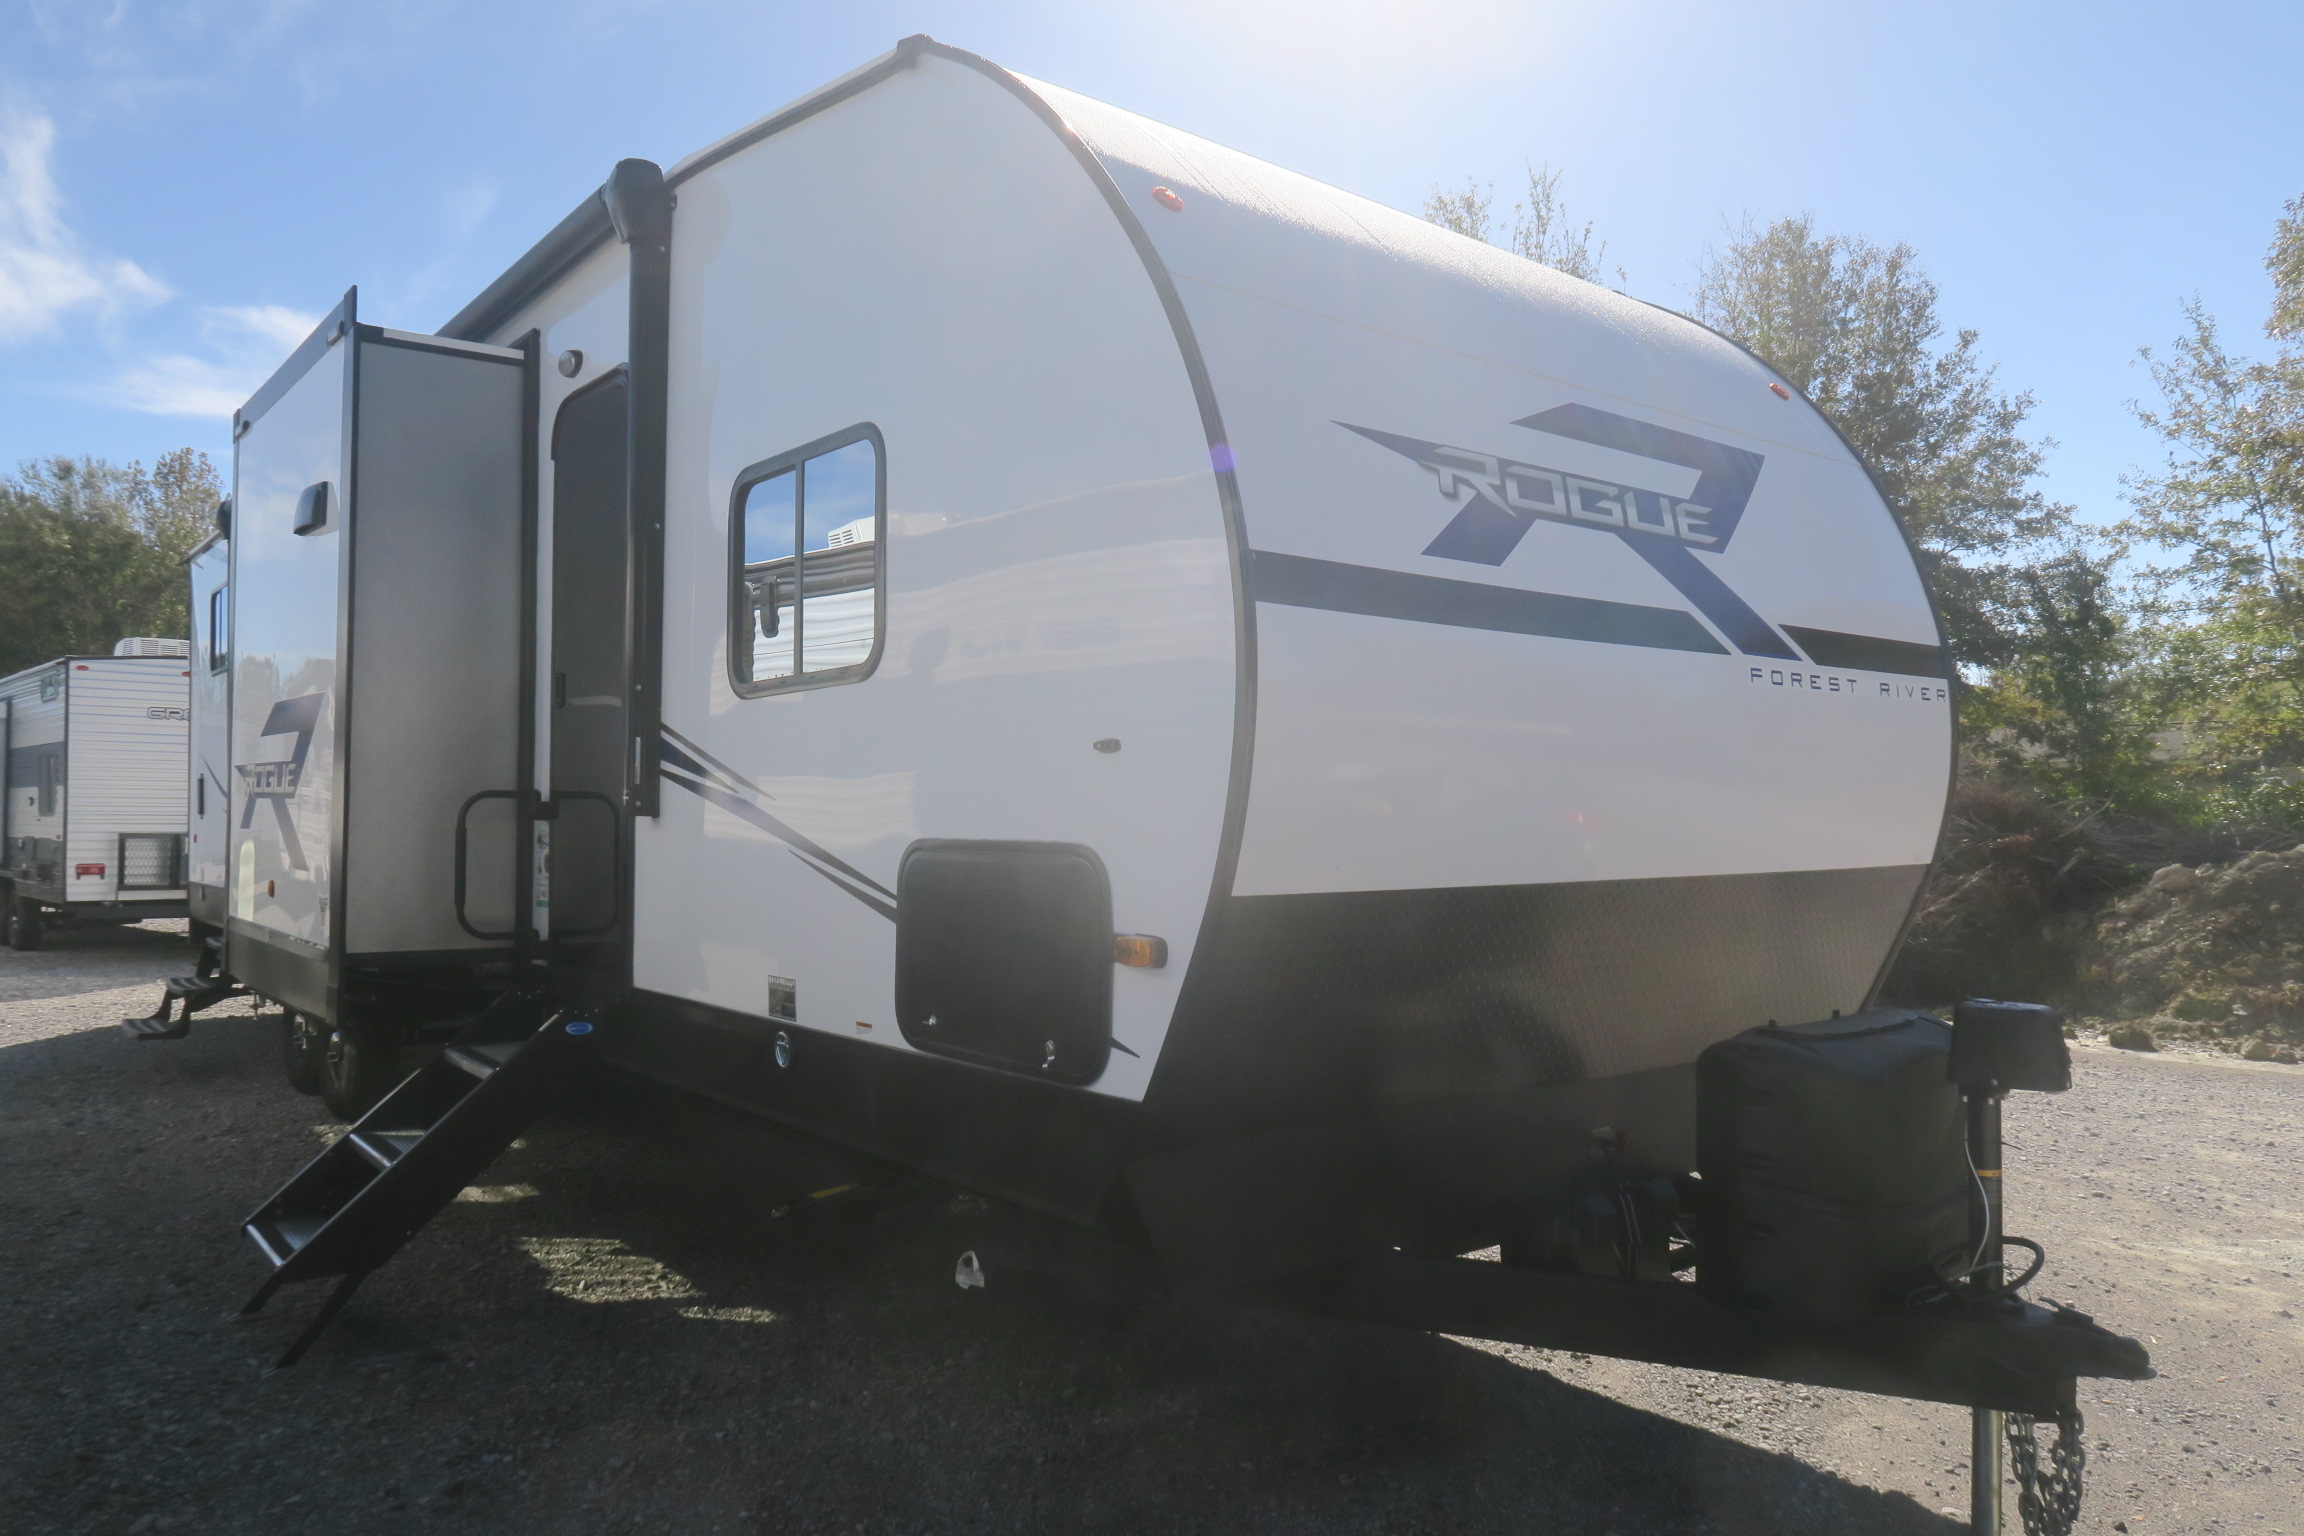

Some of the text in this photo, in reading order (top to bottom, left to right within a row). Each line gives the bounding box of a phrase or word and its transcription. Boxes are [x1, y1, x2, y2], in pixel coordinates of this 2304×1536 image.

[1417, 446, 1719, 544] ROGUE
[1750, 667, 1947, 703] FOREST RIVER
